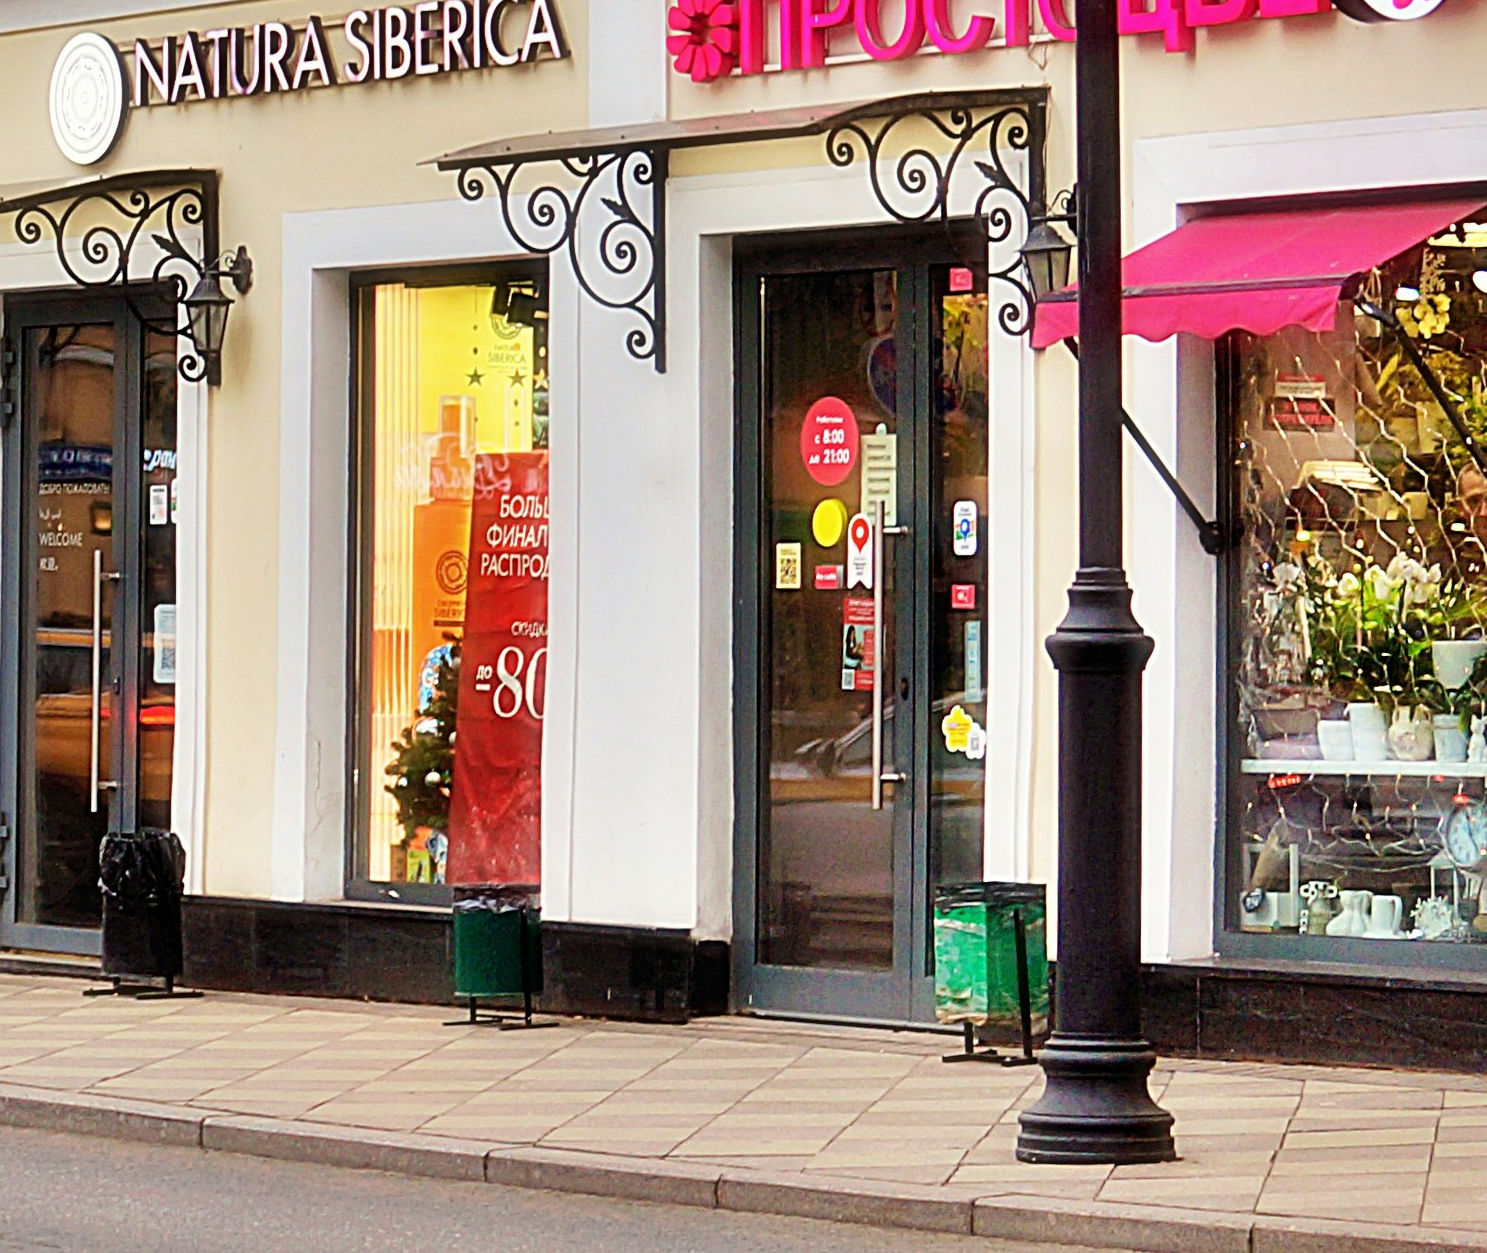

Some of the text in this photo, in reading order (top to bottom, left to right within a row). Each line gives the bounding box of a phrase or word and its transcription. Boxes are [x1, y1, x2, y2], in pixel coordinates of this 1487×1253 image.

[133, 14, 337, 108] NATURA
[823, 428, 845, 444] 8:00
[823, 448, 850, 464] 21:00
[38, 532, 83, 546] WELCOME
